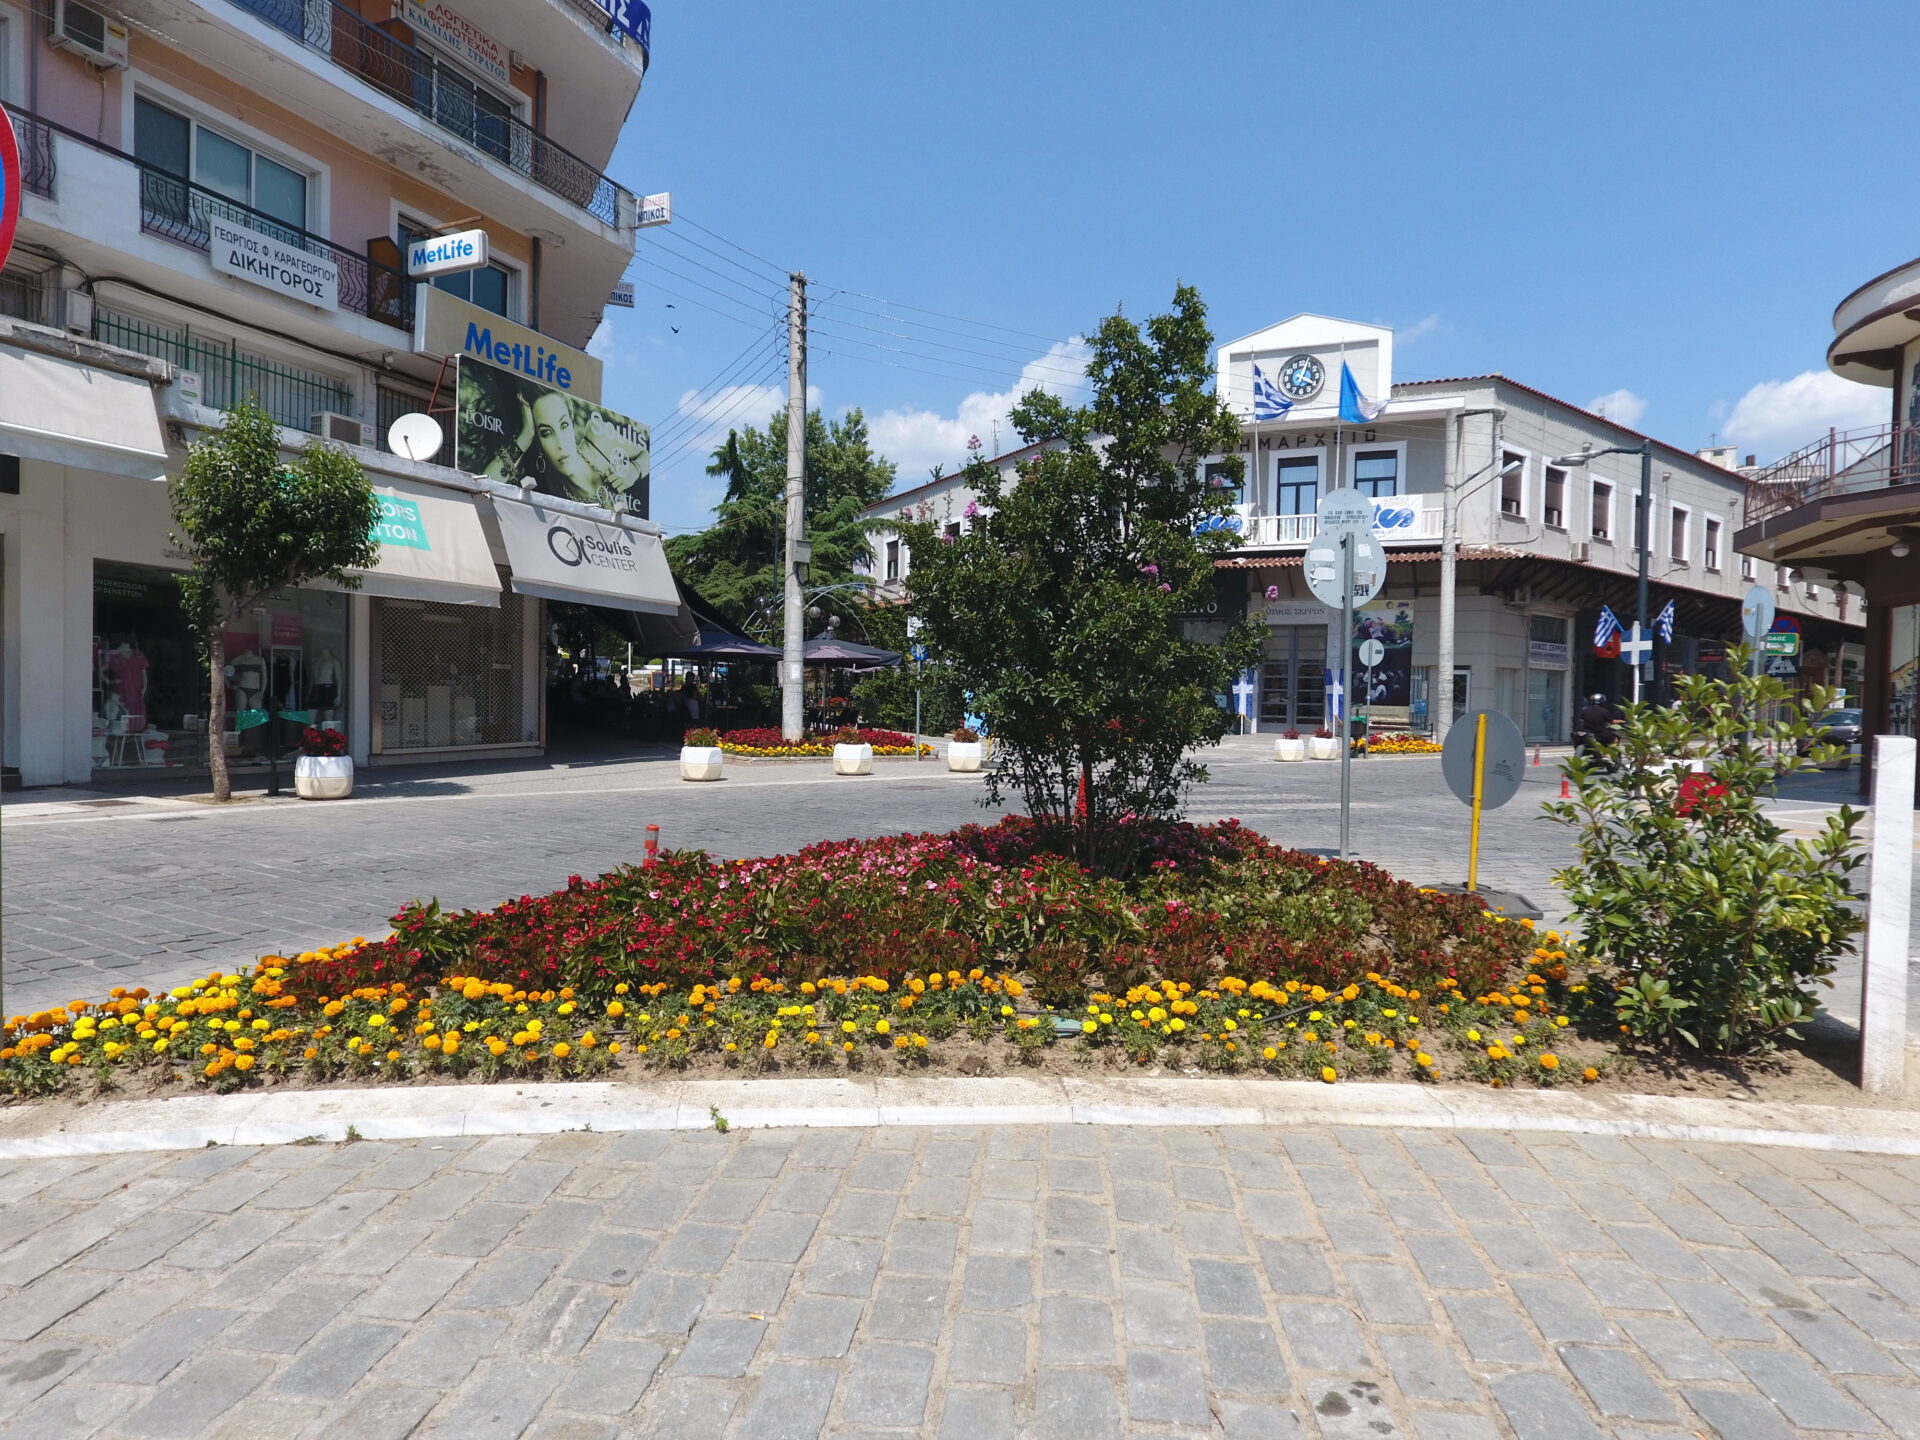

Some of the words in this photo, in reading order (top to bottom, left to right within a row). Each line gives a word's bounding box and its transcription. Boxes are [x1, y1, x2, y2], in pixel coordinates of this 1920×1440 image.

[427, 10, 505, 70] ΦΟΡΟΤΕΧΝΙΚΑ
[436, 3, 499, 54] ΛΟΓΙΣΤΙΚΑ
[468, 48, 507, 81] ΣΤΡΑΤΟΣ
[214, 226, 259, 254] ΓΕΩΡΓΙΟΣ
[262, 245, 272, 259] Φ.
[274, 249, 336, 283] ΚΑΡΑΓΕΩΡΓΙΟΥ
[412, 239, 473, 267] MetLife
[228, 250, 324, 298] ΔΙΚΗΓΟΡΟΣ
[609, 291, 633, 304] ΠΙΚΟΣ
[464, 322, 572, 389] MetLife
[584, 411, 648, 450] Soulis
[376, 502, 417, 522] ORS
[368, 521, 419, 543] TTON
[584, 535, 632, 556] Soulis
[591, 553, 638, 572] CENTER
[103, 586, 143, 599] BENETTON
